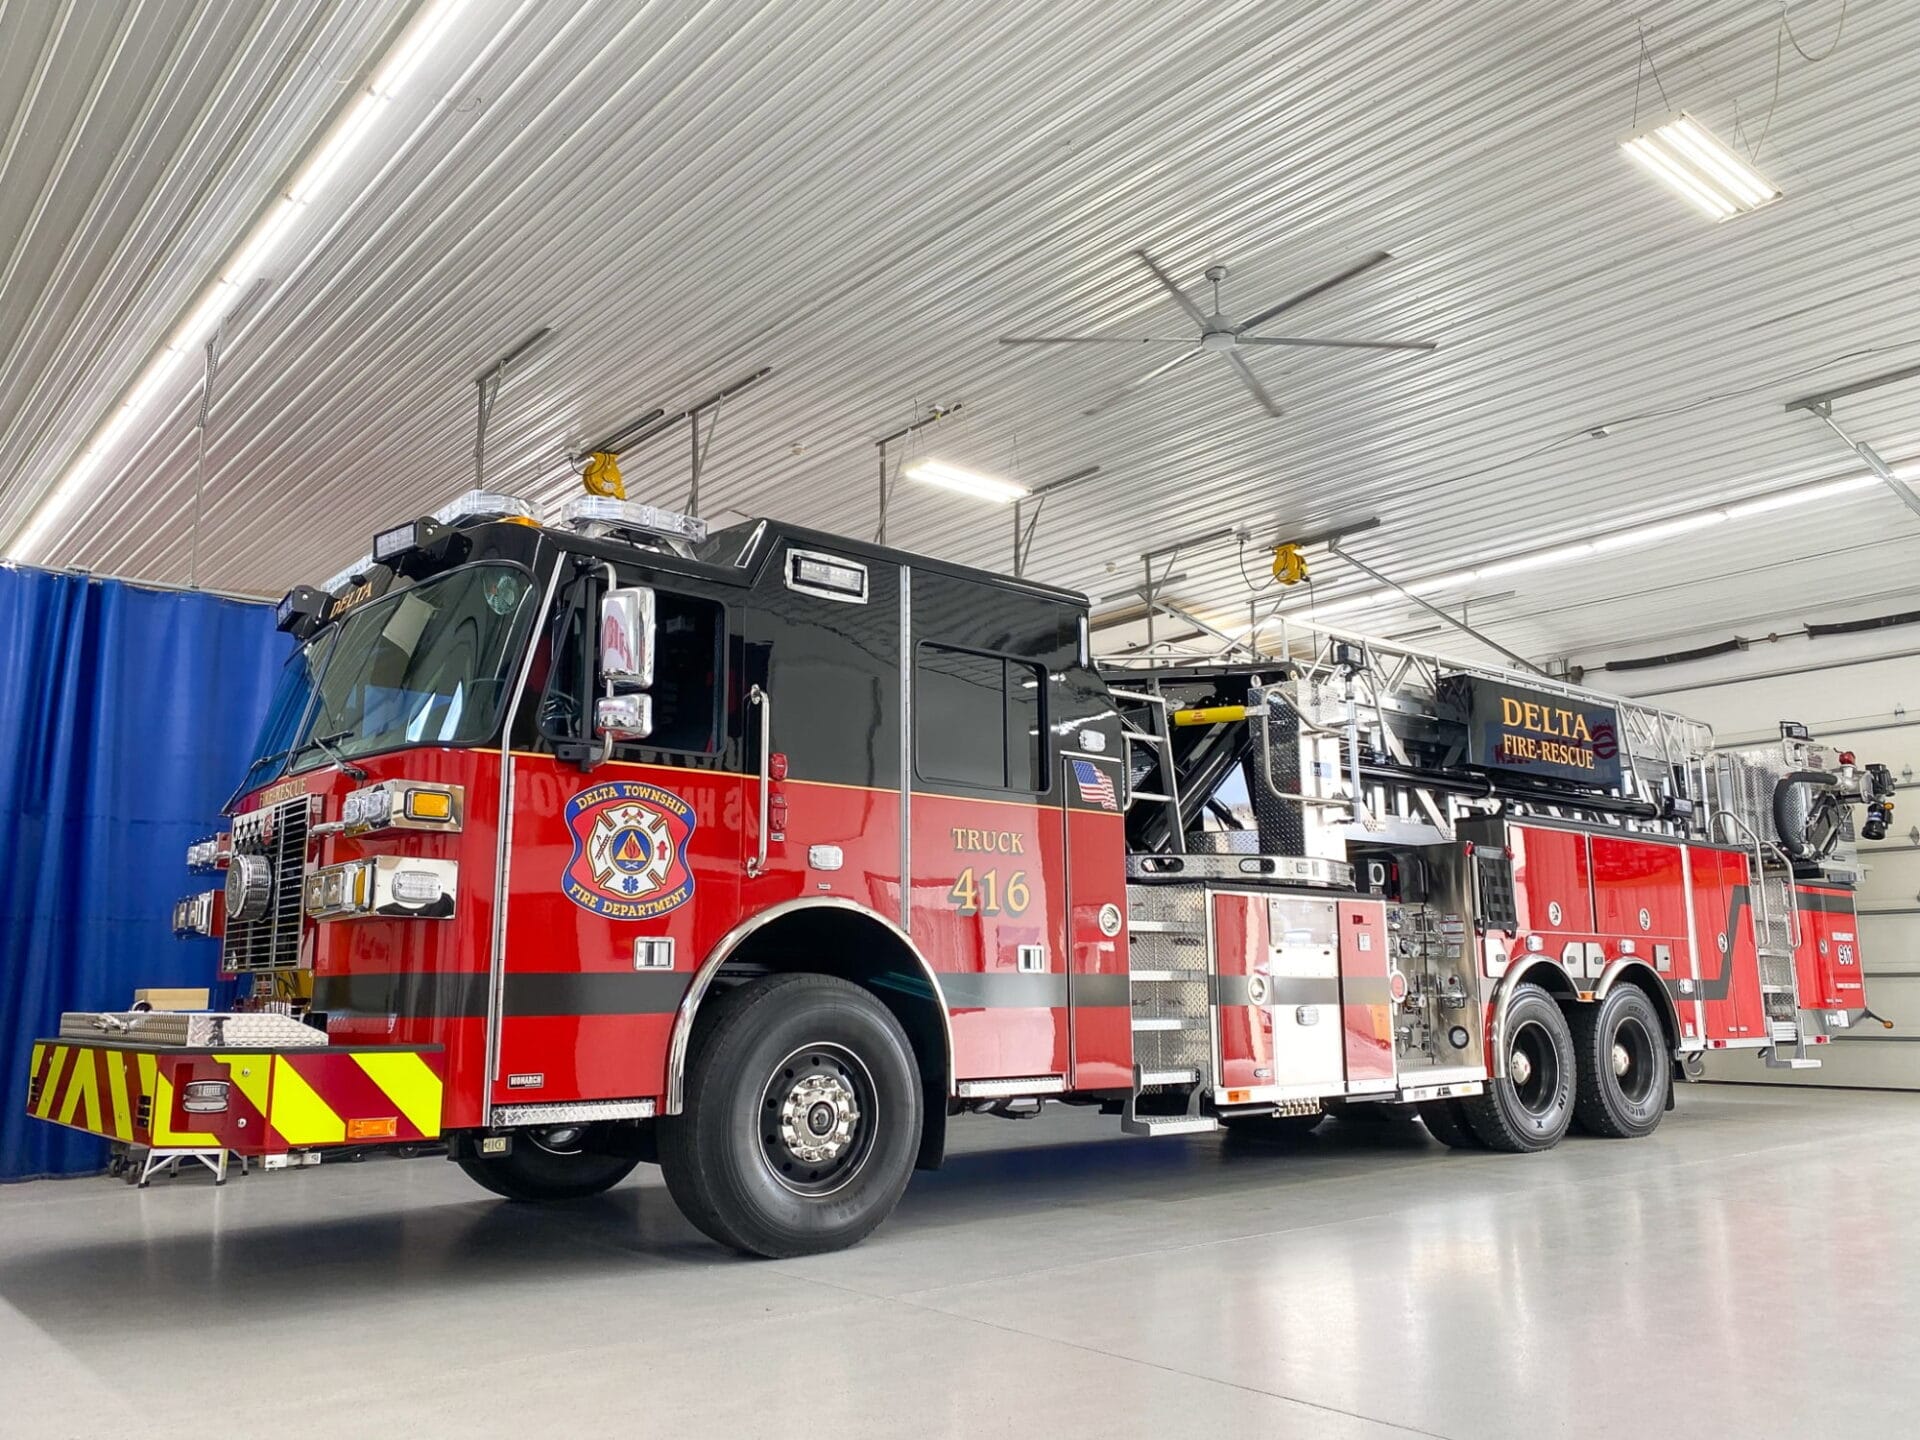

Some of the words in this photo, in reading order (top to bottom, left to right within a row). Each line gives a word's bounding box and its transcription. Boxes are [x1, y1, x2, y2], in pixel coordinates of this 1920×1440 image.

[329, 581, 373, 619] DELTA
[1501, 697, 1593, 742] DELTA
[1503, 733, 1596, 770] FIRE-RESCUE
[576, 786, 619, 810] DELTA
[623, 785, 688, 816] TOWNSHIP
[952, 827, 1025, 855] TRUCK
[569, 883, 599, 908] FIRE
[602, 887, 688, 917] DEPARTMENT
[948, 867, 1030, 918] 416
[510, 1075, 542, 1086] MONARCH
